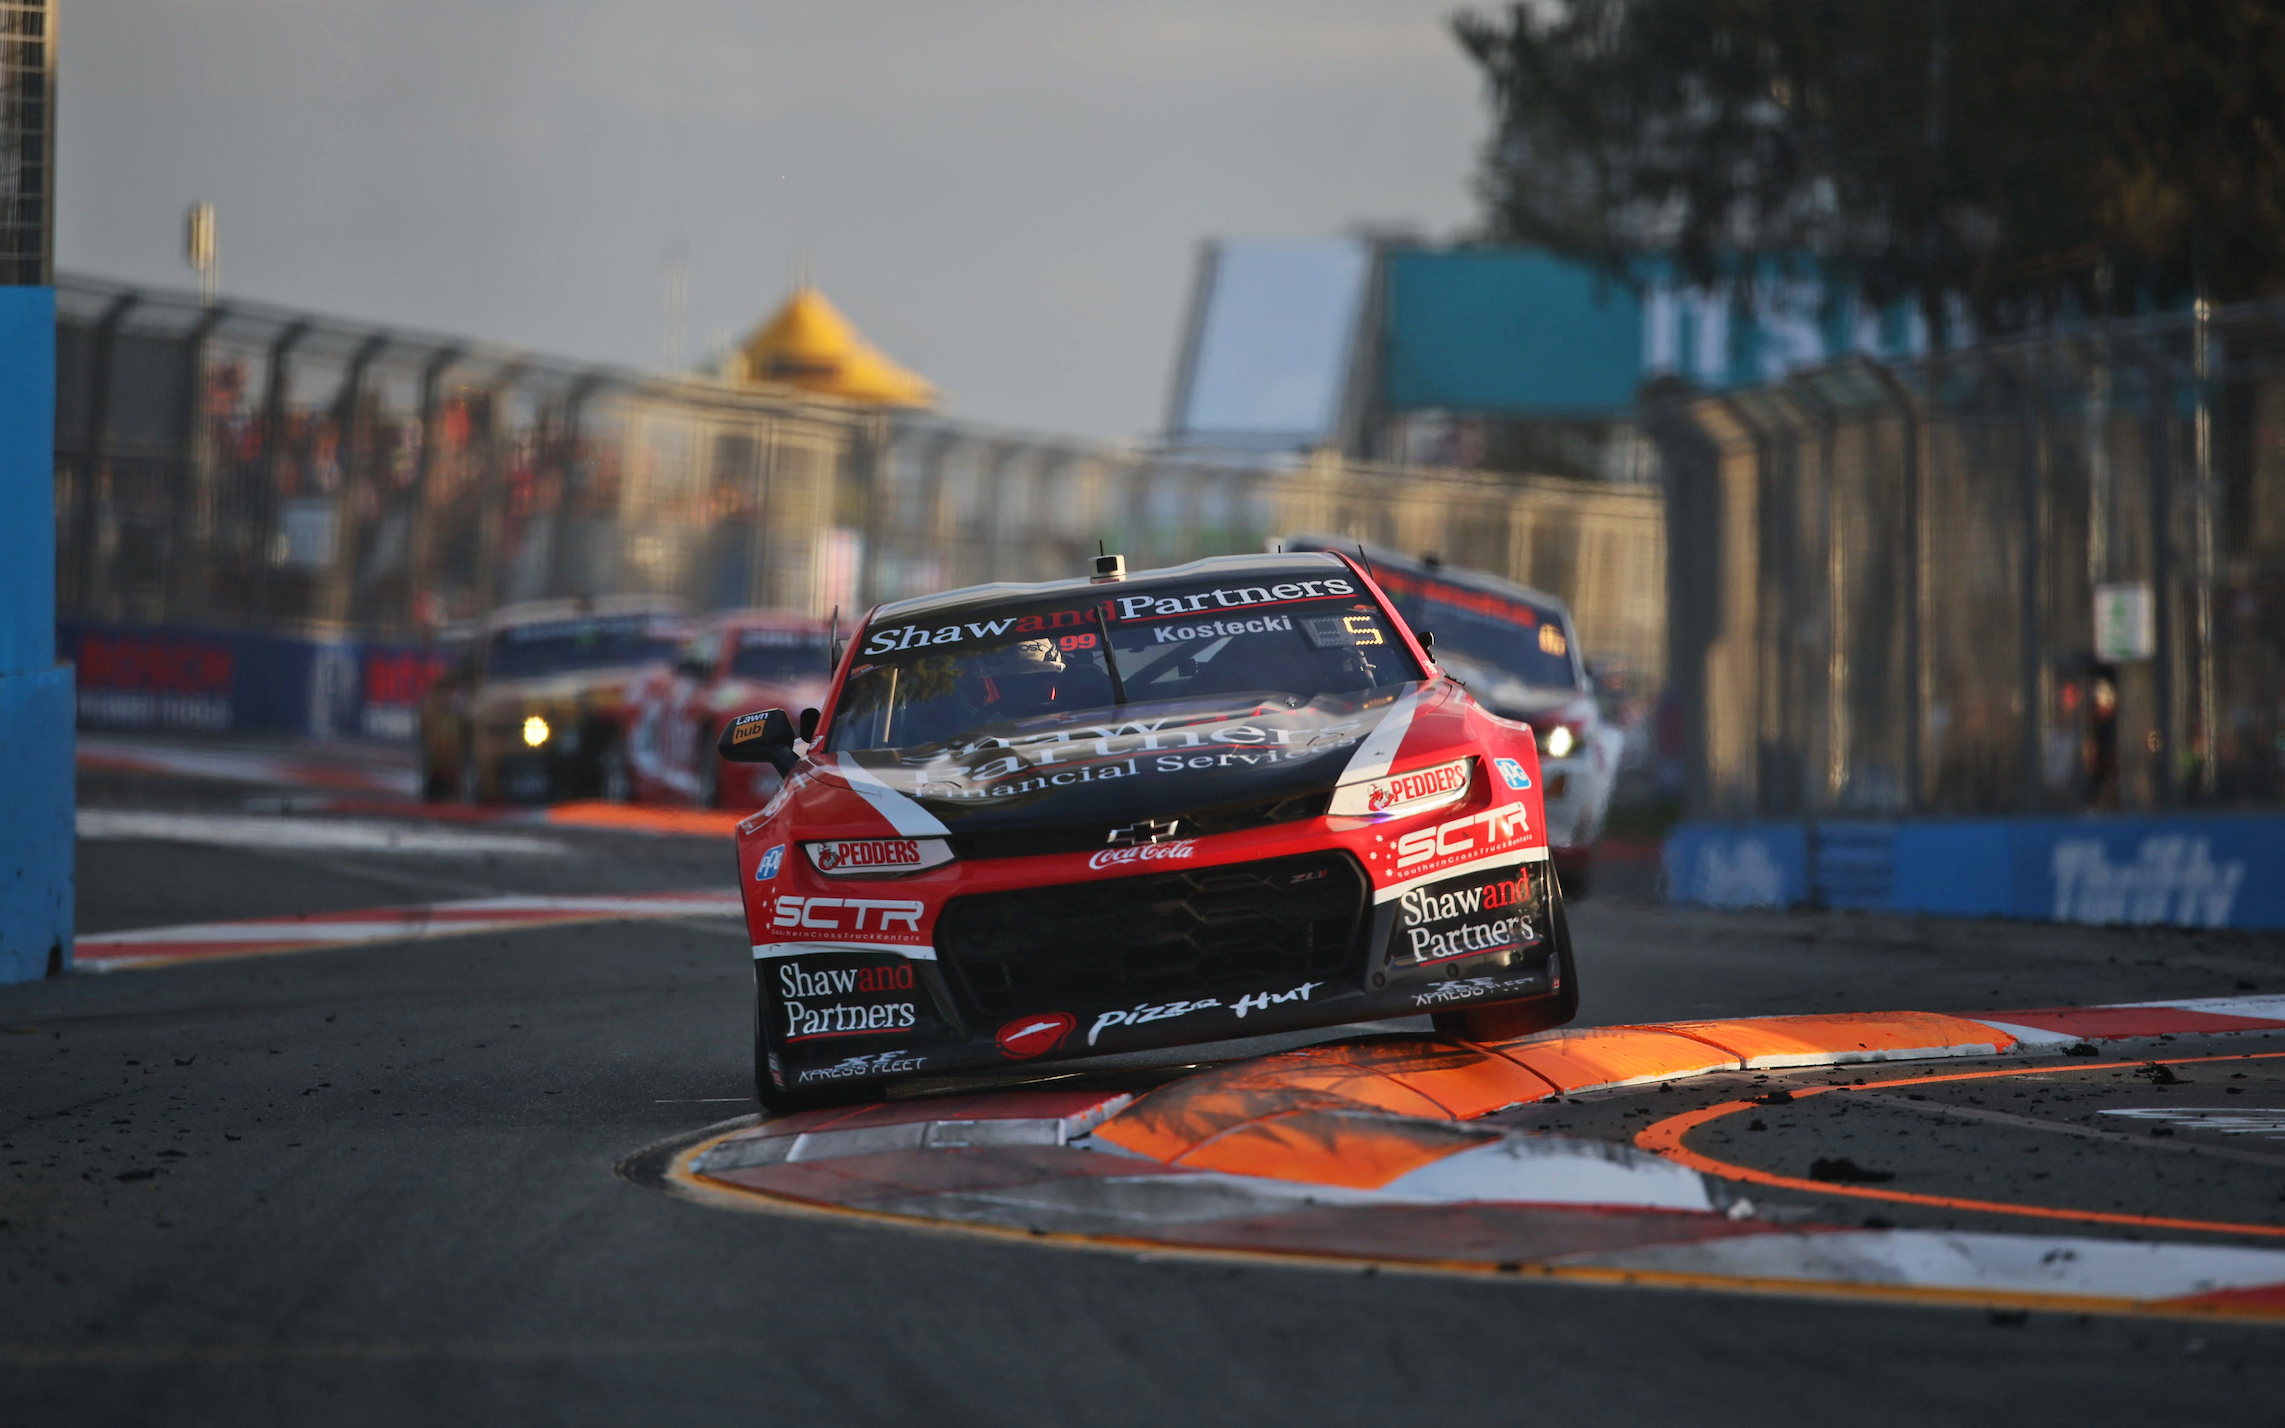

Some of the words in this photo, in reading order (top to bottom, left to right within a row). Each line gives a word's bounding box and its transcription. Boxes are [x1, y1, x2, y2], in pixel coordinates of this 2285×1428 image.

[1060, 632, 1096, 651] 99
[1153, 614, 1293, 643] Kostecki
[734, 724, 762, 740] hub
[735, 712, 769, 726] Lawn
[1391, 764, 1466, 803] PEDDERS
[1397, 800, 1530, 868] SCTR
[838, 840, 921, 866] PEDDERS
[773, 895, 925, 932] SCTR
[1407, 914, 1534, 963] Partners
[1229, 981, 1325, 1019] Hut
[784, 1001, 916, 1037] Partners
[798, 1064, 869, 1083] XPRESS
[871, 1056, 928, 1074] FLEET
